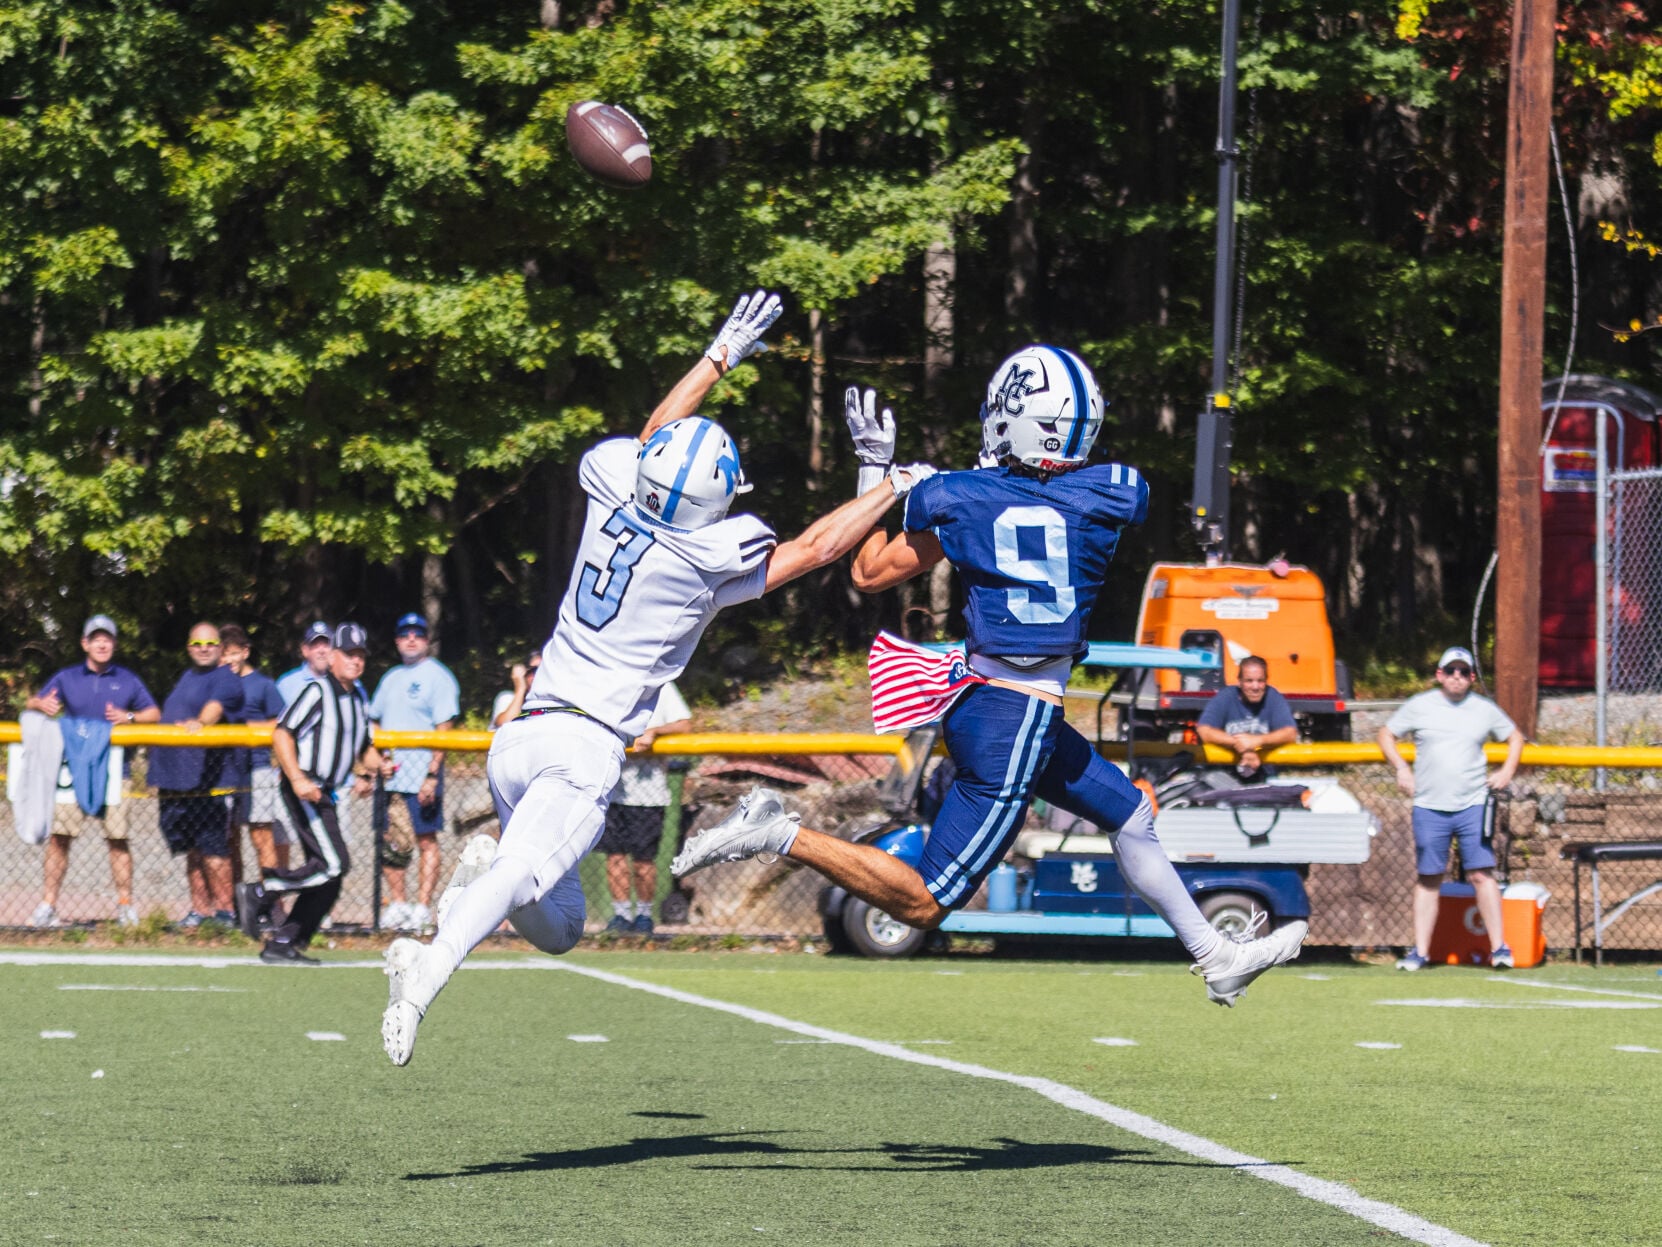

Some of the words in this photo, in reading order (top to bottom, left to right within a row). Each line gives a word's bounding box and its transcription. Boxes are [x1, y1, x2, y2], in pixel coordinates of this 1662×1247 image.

[1040, 458, 1084, 473] Riddel
[1046, 440, 1059, 450] GG
[575, 507, 657, 633] 3
[993, 505, 1076, 624] 9
